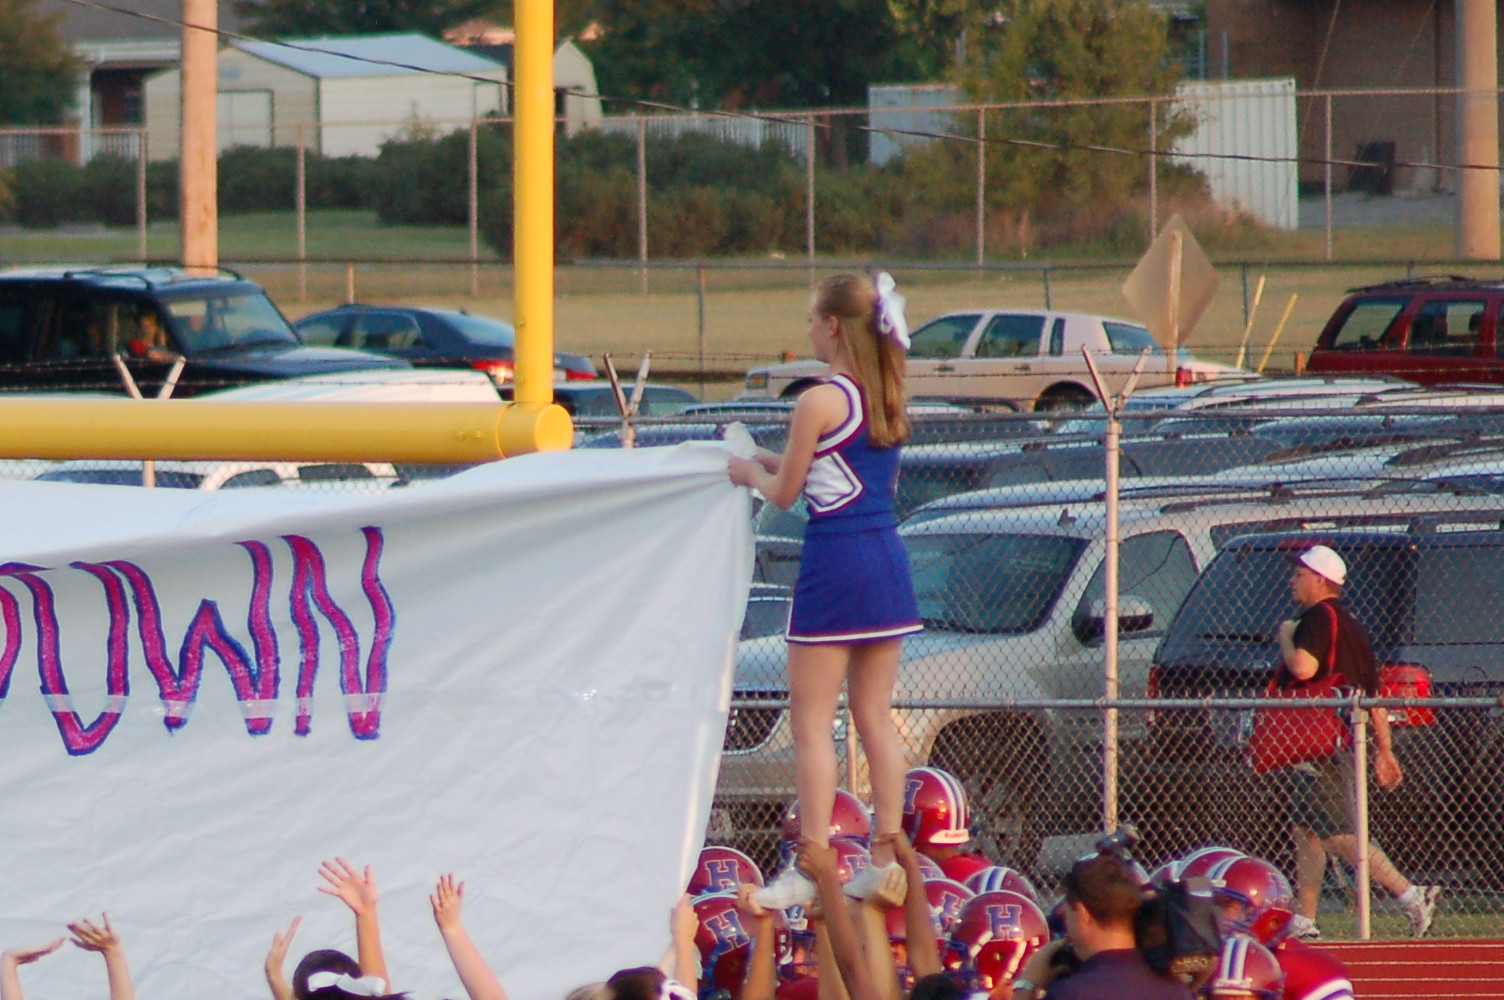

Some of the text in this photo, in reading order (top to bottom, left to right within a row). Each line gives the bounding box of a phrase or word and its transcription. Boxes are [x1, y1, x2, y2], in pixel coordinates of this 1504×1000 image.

[705, 858, 740, 890] H
[703, 908, 750, 956] H
[986, 903, 1024, 942] H
